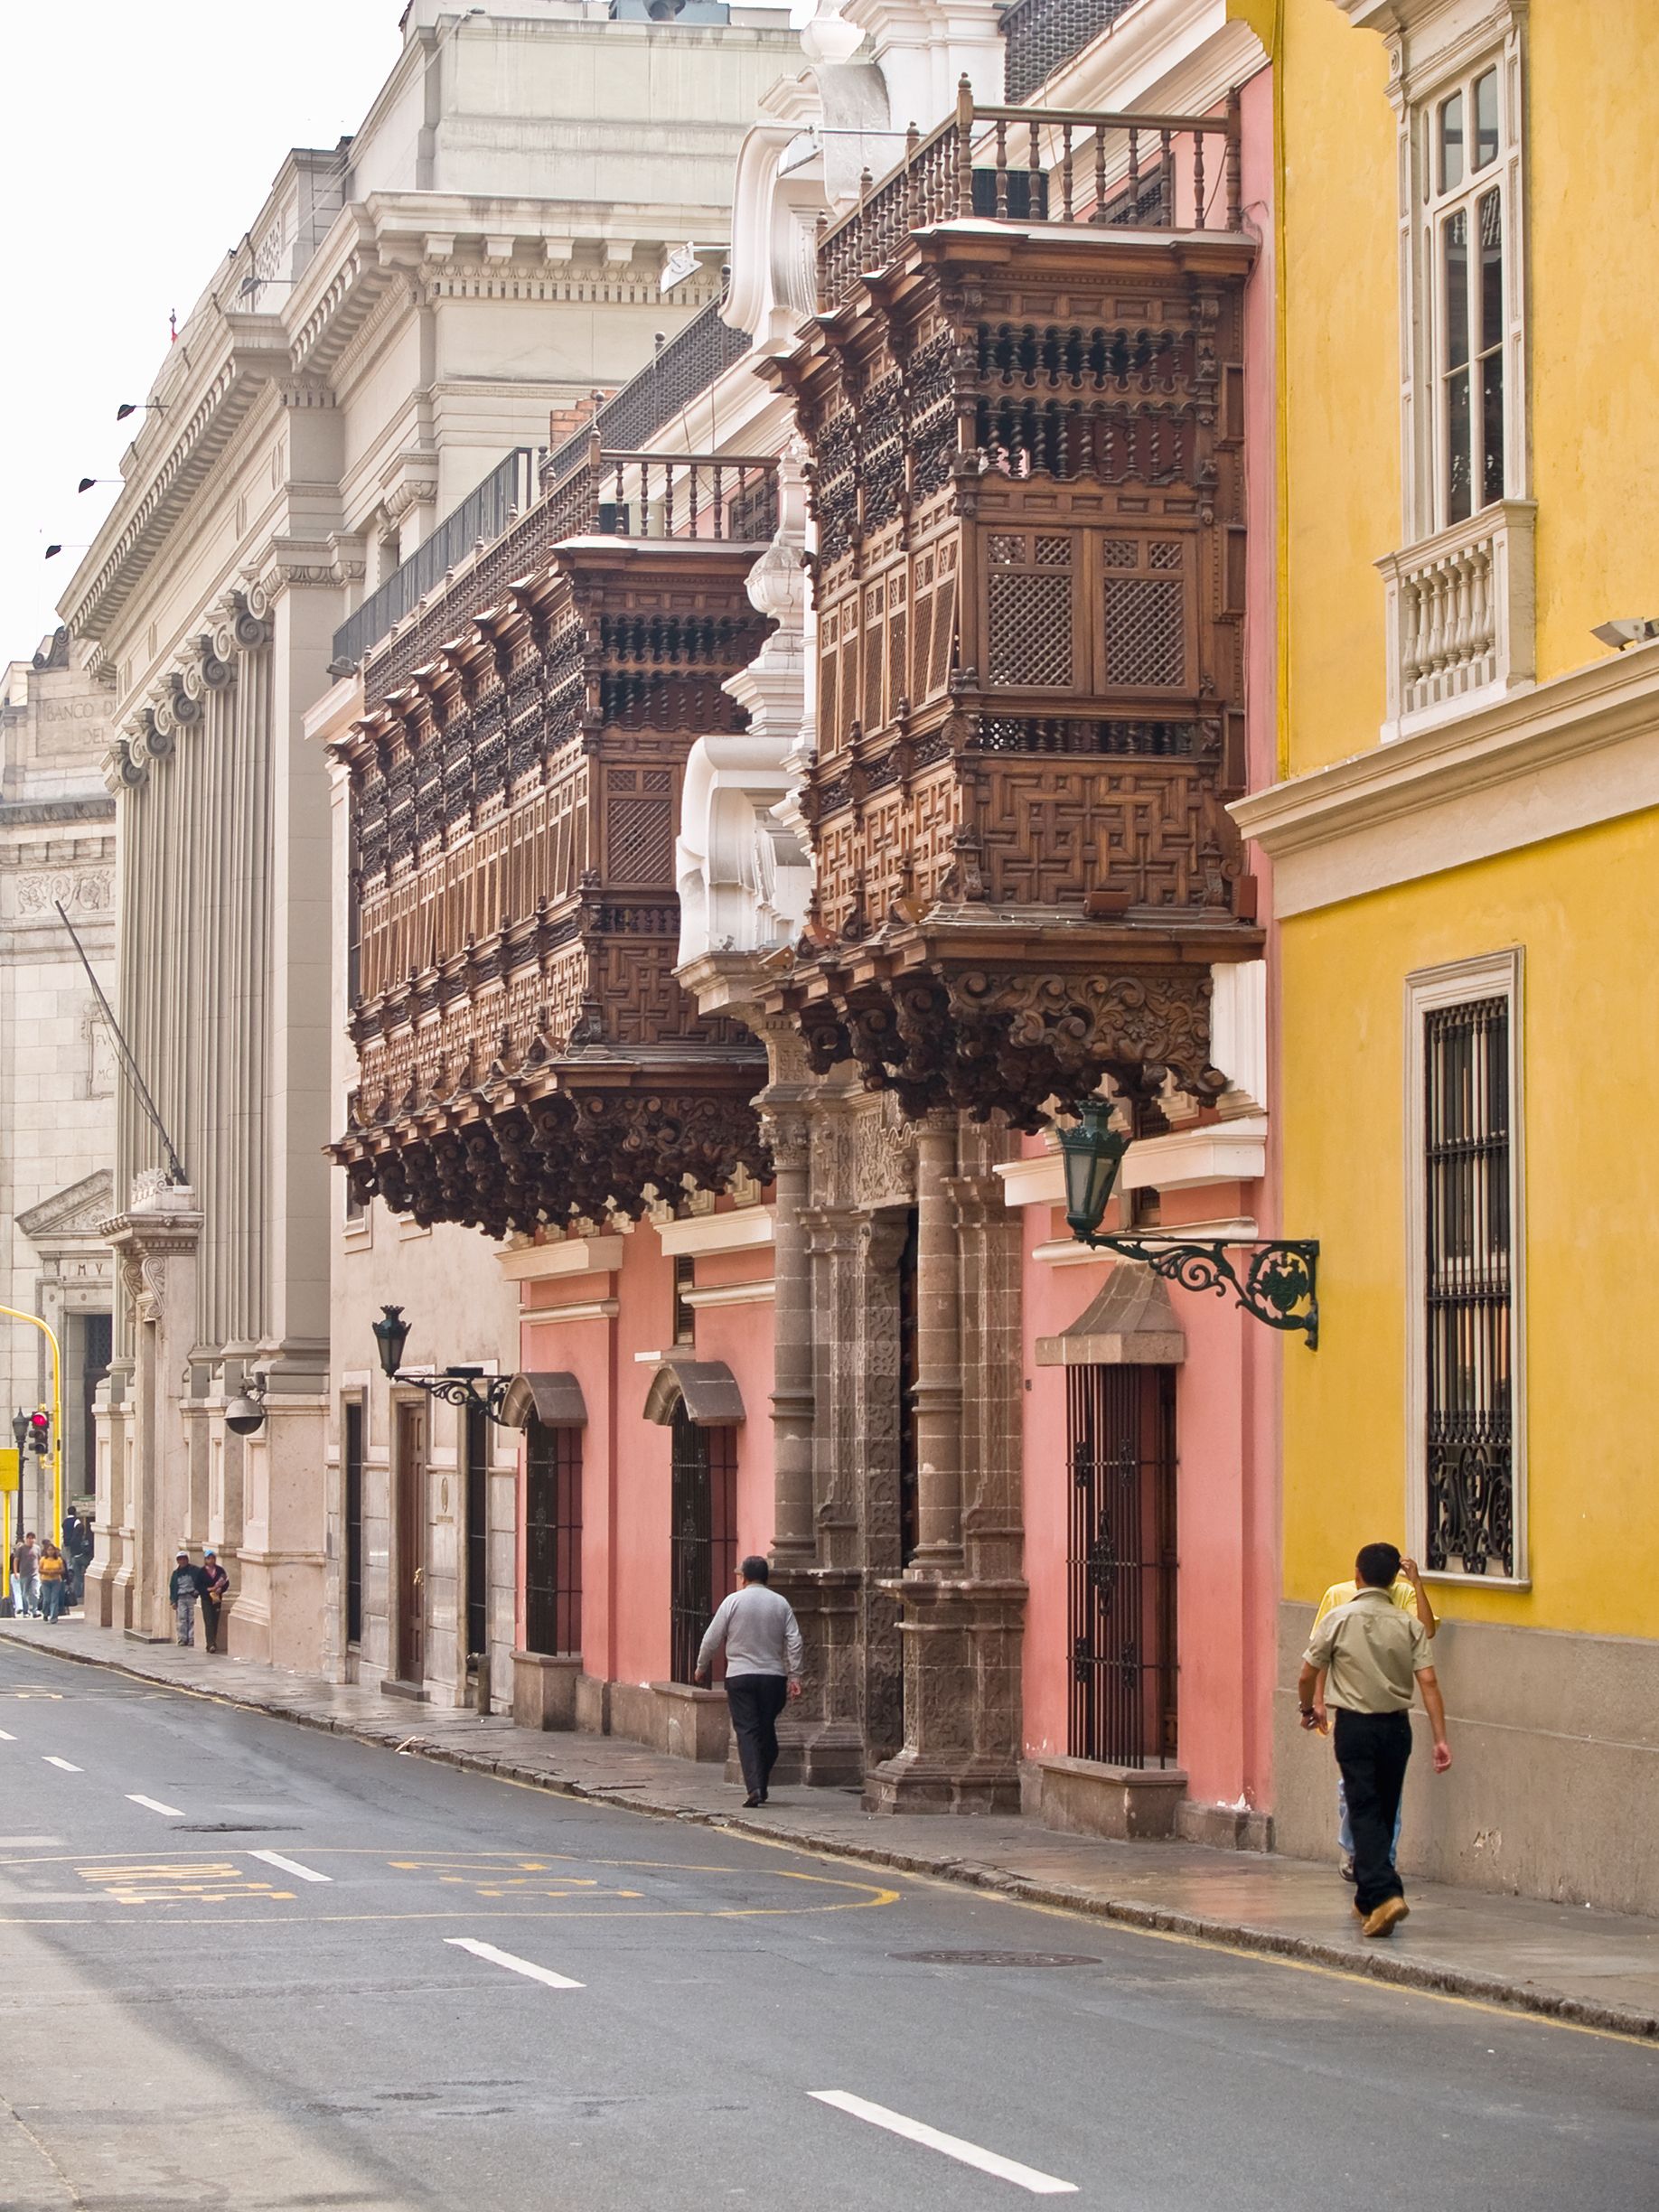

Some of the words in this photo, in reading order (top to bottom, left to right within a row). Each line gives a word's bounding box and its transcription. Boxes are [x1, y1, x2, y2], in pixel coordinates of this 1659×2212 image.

[47, 702, 94, 722] BANCO
[103, 700, 117, 717] D
[80, 726, 109, 745] DEL
